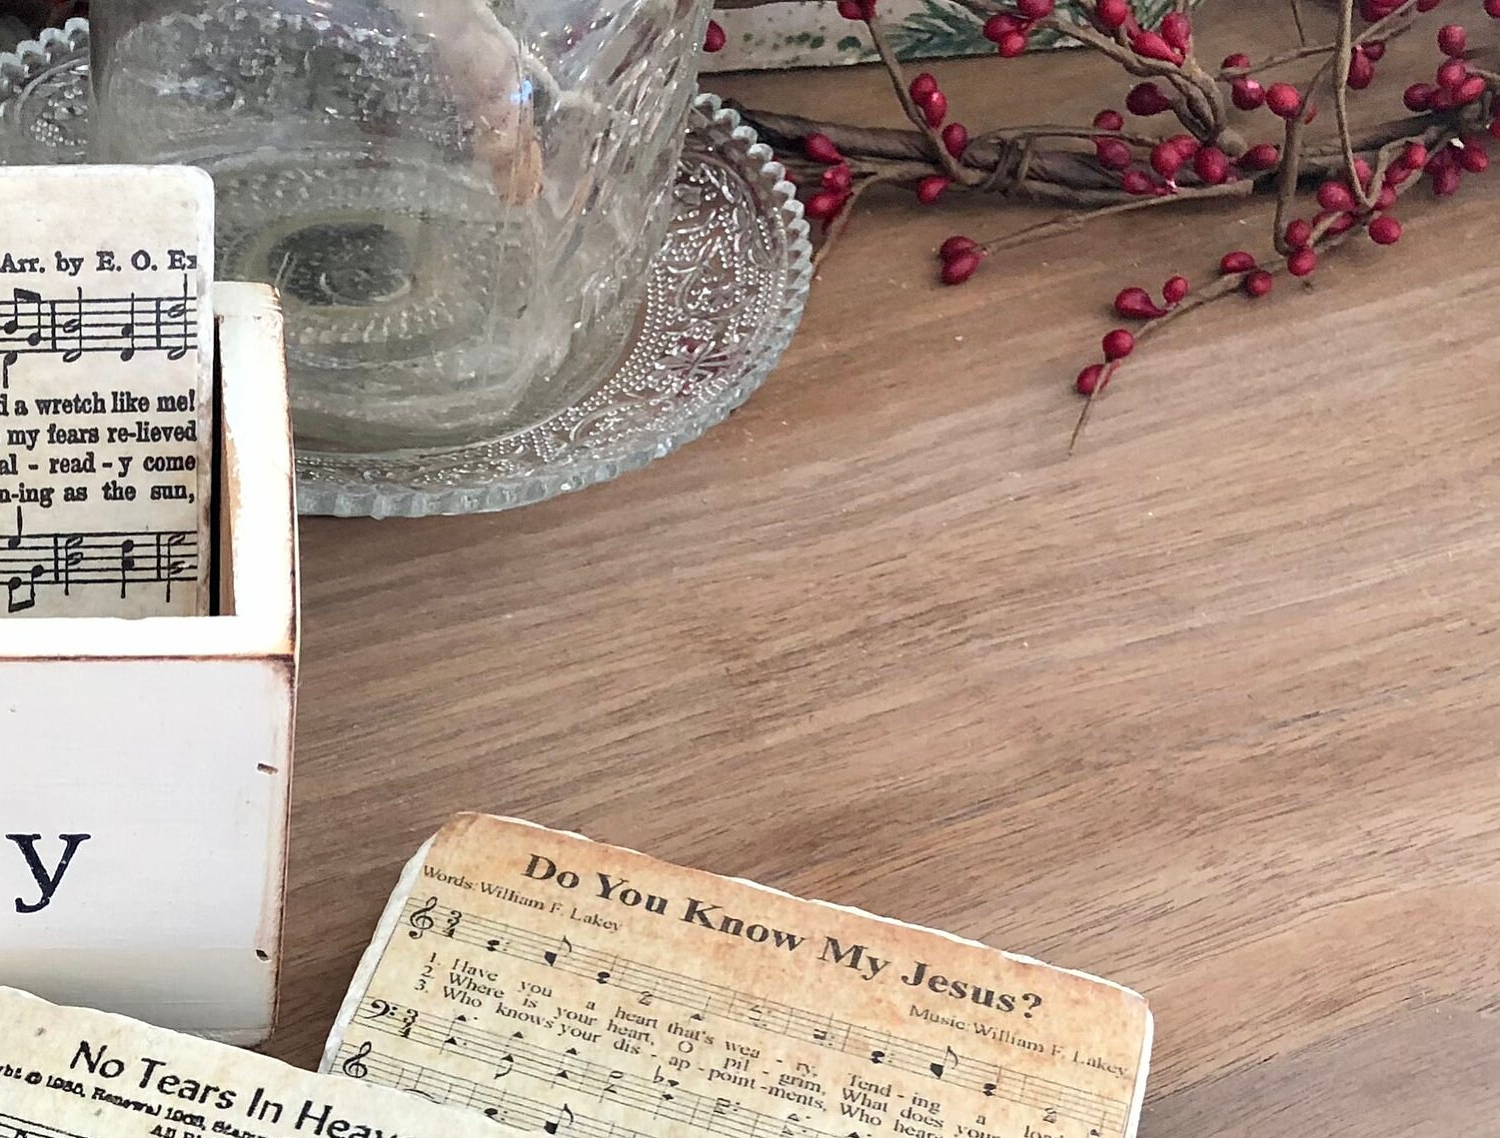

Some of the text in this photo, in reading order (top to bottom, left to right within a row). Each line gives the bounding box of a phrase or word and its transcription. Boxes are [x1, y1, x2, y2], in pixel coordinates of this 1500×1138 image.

[54, 250, 85, 277] by
[95, 250, 122, 272] E.
[130, 249, 158, 272] O.
[14, 399, 29, 417] a
[34, 391, 107, 416] wretch
[110, 390, 150, 414] like
[156, 388, 196, 413] me!
[6, 428, 41, 452] my
[46, 422, 100, 445] fears
[142, 455, 199, 473] come
[63, 486, 88, 503] as
[101, 479, 137, 502] the
[149, 484, 195, 504] sun,
[480, 881, 545, 911] William
[548, 902, 564, 916] F.
[569, 907, 622, 934] Lakey
[522, 853, 1043, 1019] Do You Know My Jesus?
[451, 957, 499, 984] Have
[517, 981, 553, 998] you
[585, 1001, 596, 1011] a
[614, 1005, 658, 1029] heart
[667, 1021, 715, 1045] that's
[973, 1022, 1044, 1053] William
[1050, 1043, 1065, 1060] F.
[1072, 1050, 1128, 1079] Lakey
[69, 1040, 125, 1079] No
[138, 1057, 237, 1110] Tears
[246, 1087, 284, 1124] In
